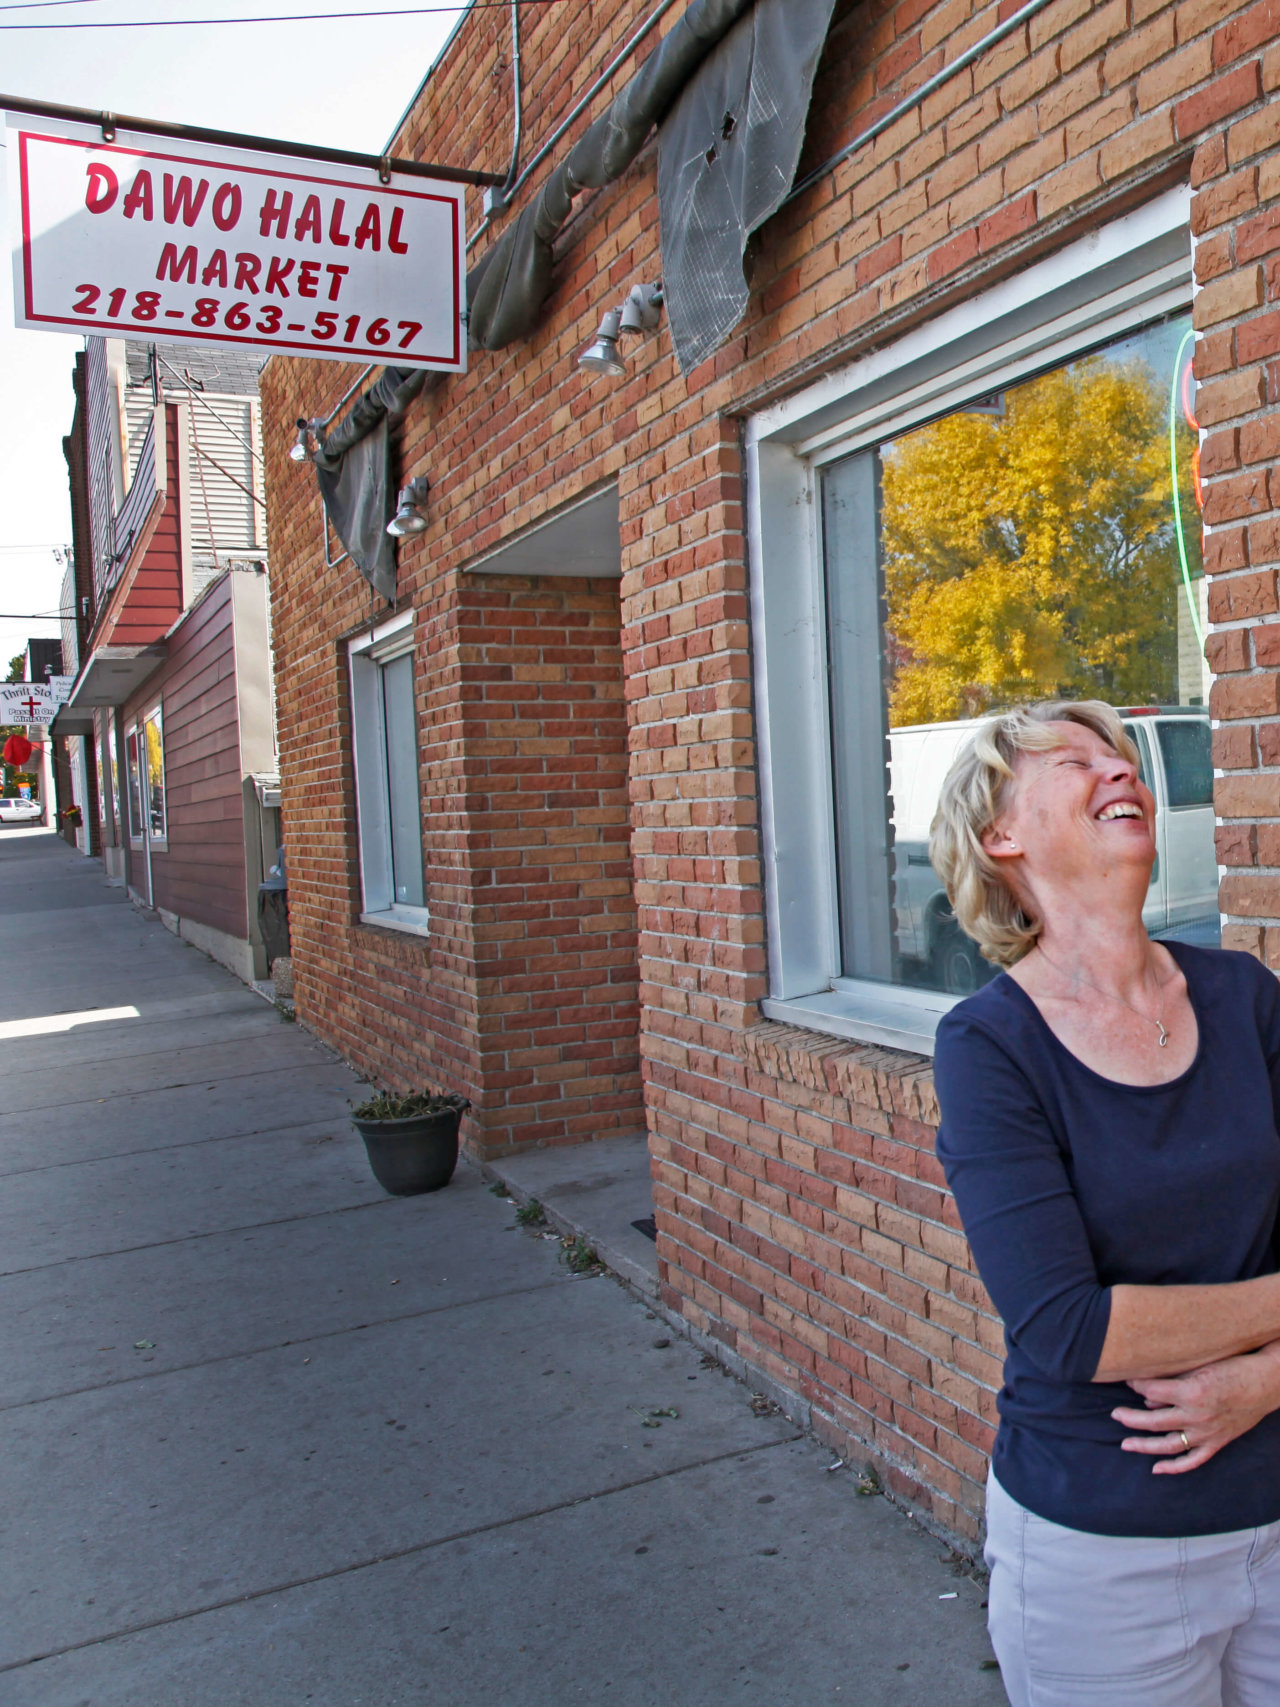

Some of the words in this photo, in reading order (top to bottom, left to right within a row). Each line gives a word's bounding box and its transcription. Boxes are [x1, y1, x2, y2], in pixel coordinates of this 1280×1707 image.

[85, 162, 242, 232] DAWO
[259, 188, 409, 255] HALAL
[156, 242, 350, 302] MARKET
[71, 284, 423, 350] 218-863-5167
[1, 686, 30, 700] Thrift
[41, 707, 55, 716] On
